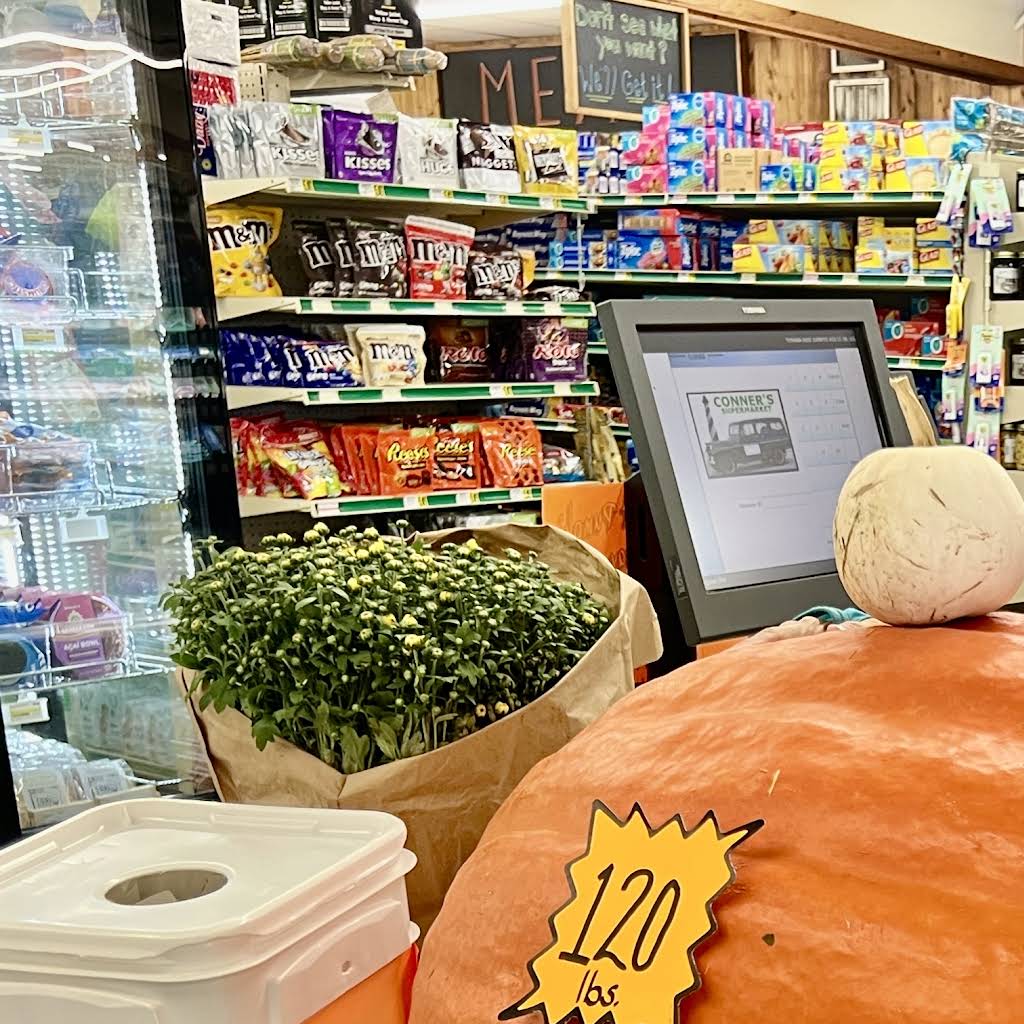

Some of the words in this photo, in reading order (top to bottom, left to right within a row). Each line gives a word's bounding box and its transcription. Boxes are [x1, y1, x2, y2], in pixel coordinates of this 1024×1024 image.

[480, 56, 561, 127] ME
[344, 155, 391, 171] KISSES
[713, 393, 775, 408] CONNER'S
[721, 404, 772, 415] SUPERMARKET
[558, 863, 680, 972] 120
